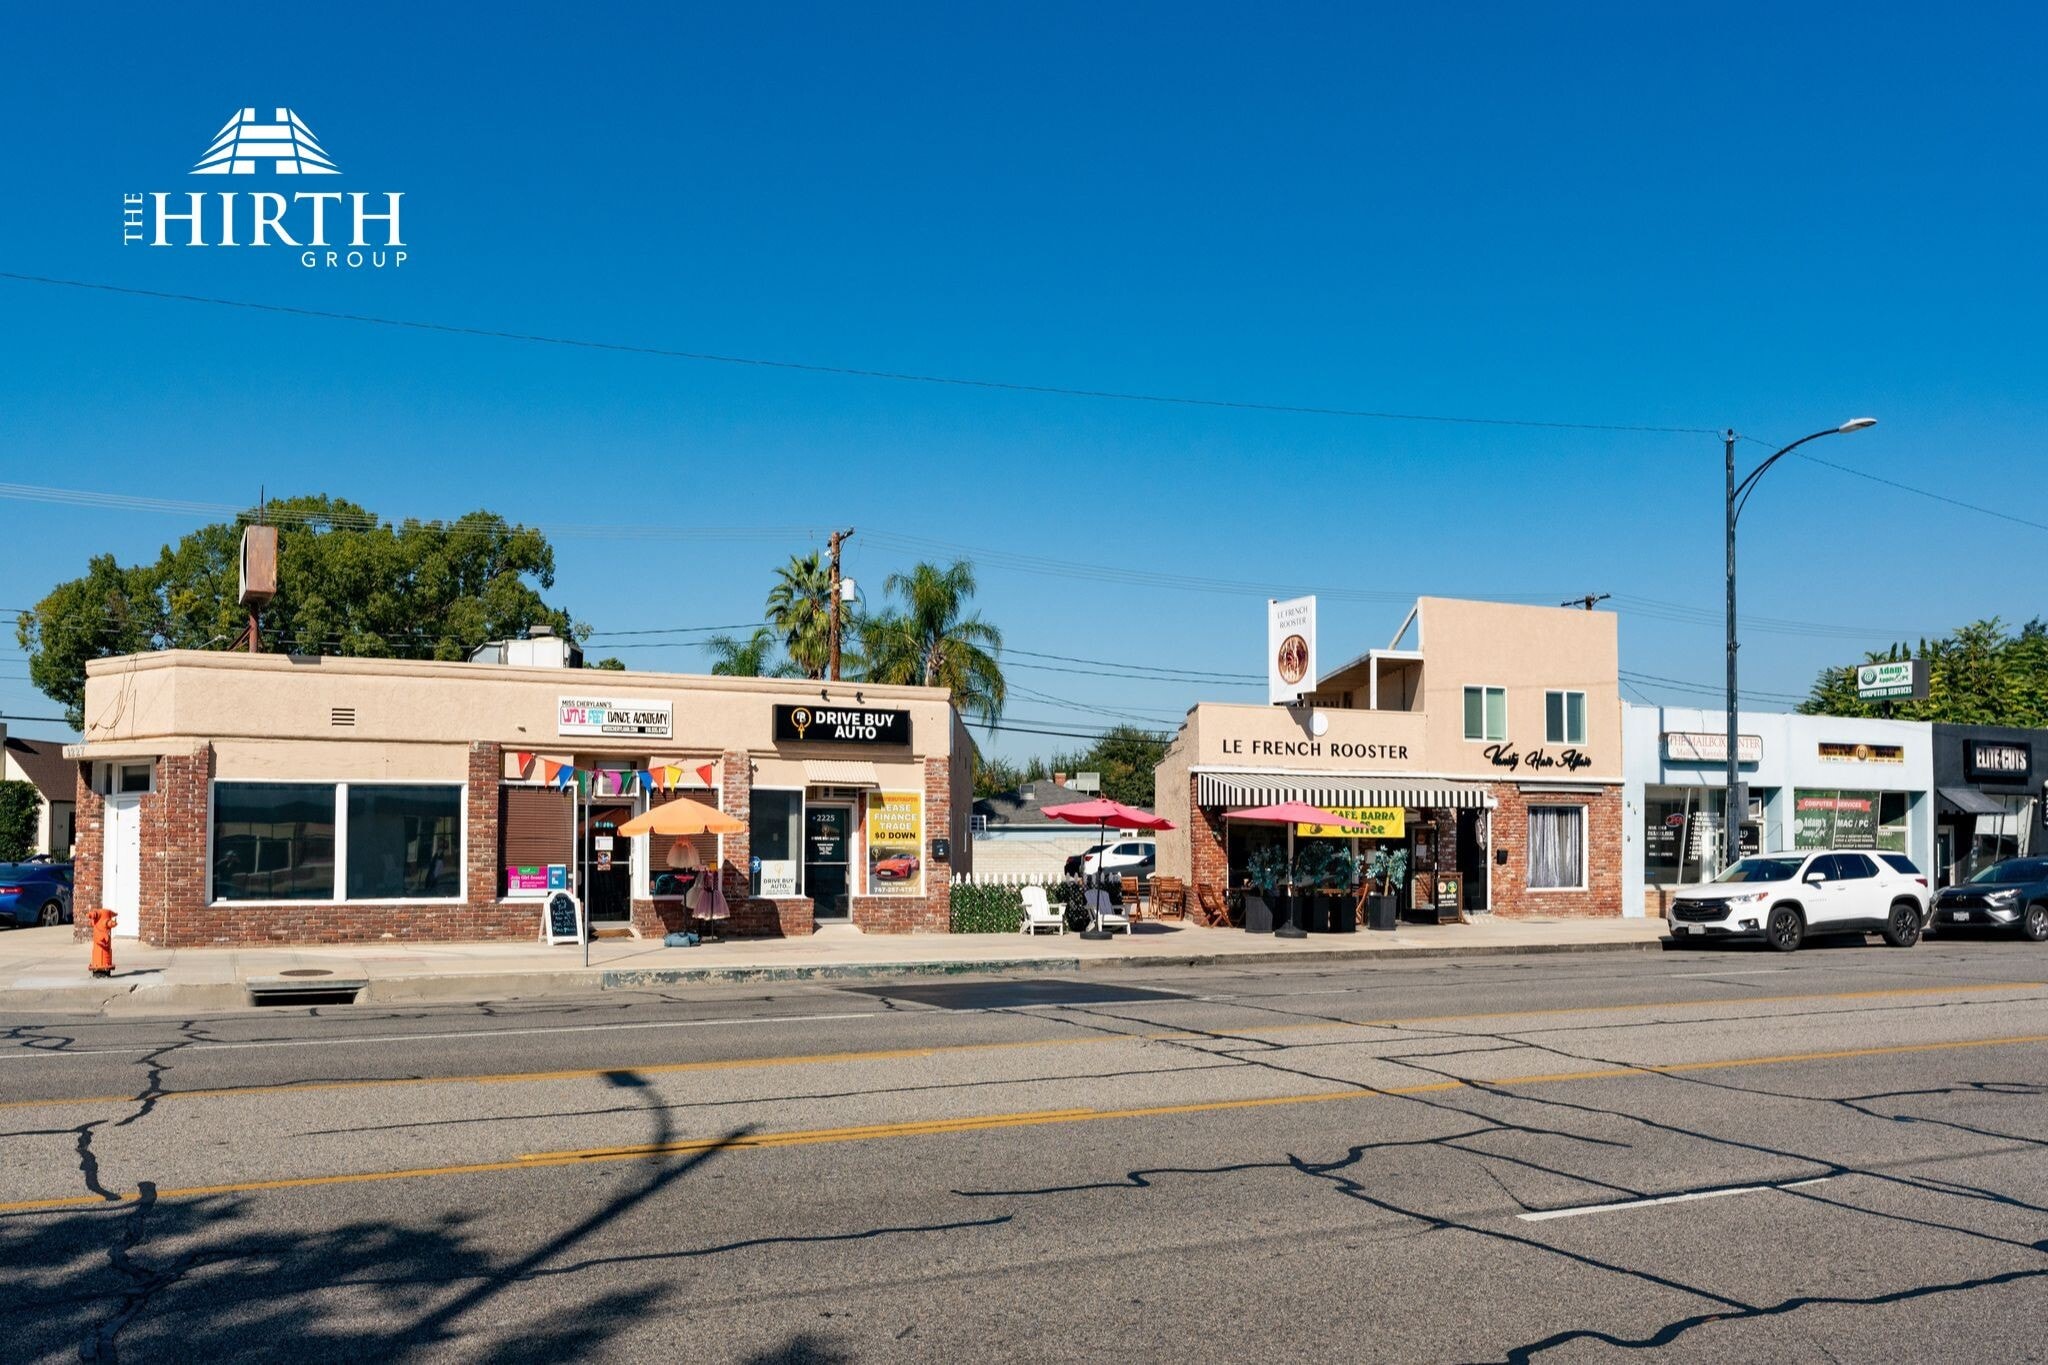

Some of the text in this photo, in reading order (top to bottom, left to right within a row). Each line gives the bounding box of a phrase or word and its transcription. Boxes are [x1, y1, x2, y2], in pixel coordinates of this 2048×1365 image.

[1280, 617, 1307, 629] ROOSTER
[1879, 665, 1909, 675] Adam's
[1859, 685, 1913, 699] COMPUTER SERVICES
[561, 700, 612, 709] MISS CHERYLANN'S
[607, 711, 631, 725] DANCE
[633, 711, 668, 726] ACADEMY
[815, 711, 895, 728] DRIVE BUY
[834, 725, 877, 740] AUTO
[1687, 735, 1726, 748] MAILBOX
[1738, 738, 1761, 749] NTER
[1222, 739, 1409, 760] LE FRENCH ROOSTER
[1483, 742, 1593, 773] Vanity Hair Affair
[1976, 747, 2027, 771] ELITE CUTS
[880, 804, 912, 812] LEASE
[1804, 800, 1833, 808] COMPUTER
[816, 814, 836, 822] 2225
[874, 813, 918, 821] FINANCE
[1361, 810, 1396, 821] BARRA
[880, 822, 913, 830] TRADE
[1803, 817, 1827, 828] Adam's
[1837, 819, 1853, 828] MAC
[1858, 820, 1869, 828] PC
[874, 831, 916, 841] $0 DOWN
